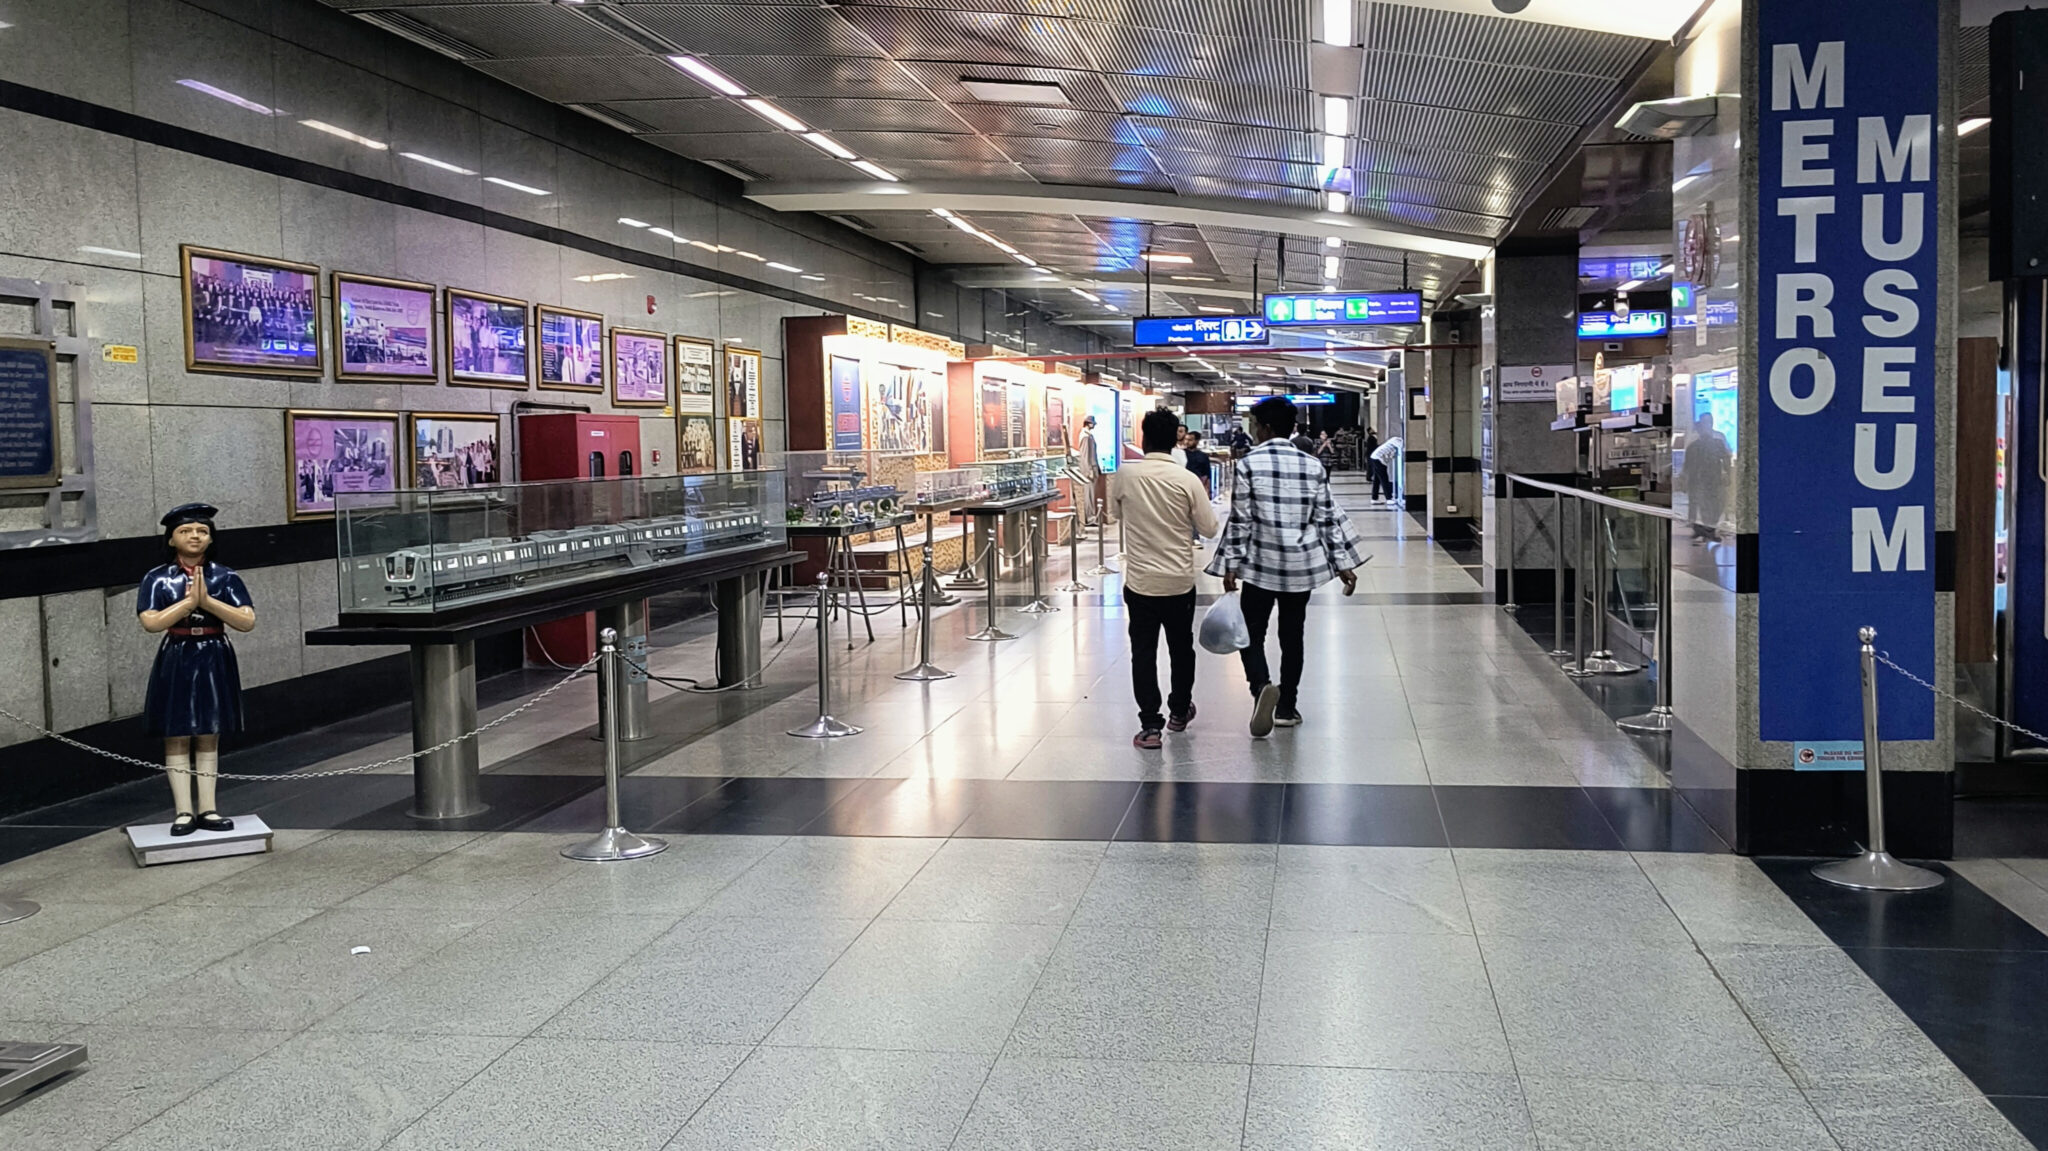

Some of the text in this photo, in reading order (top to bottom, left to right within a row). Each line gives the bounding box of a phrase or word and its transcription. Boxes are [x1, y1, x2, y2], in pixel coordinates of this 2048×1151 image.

[1204, 333, 1220, 341] Lift
[1769, 40, 1845, 415] METRO
[1851, 114, 1931, 572] MUSEUM
